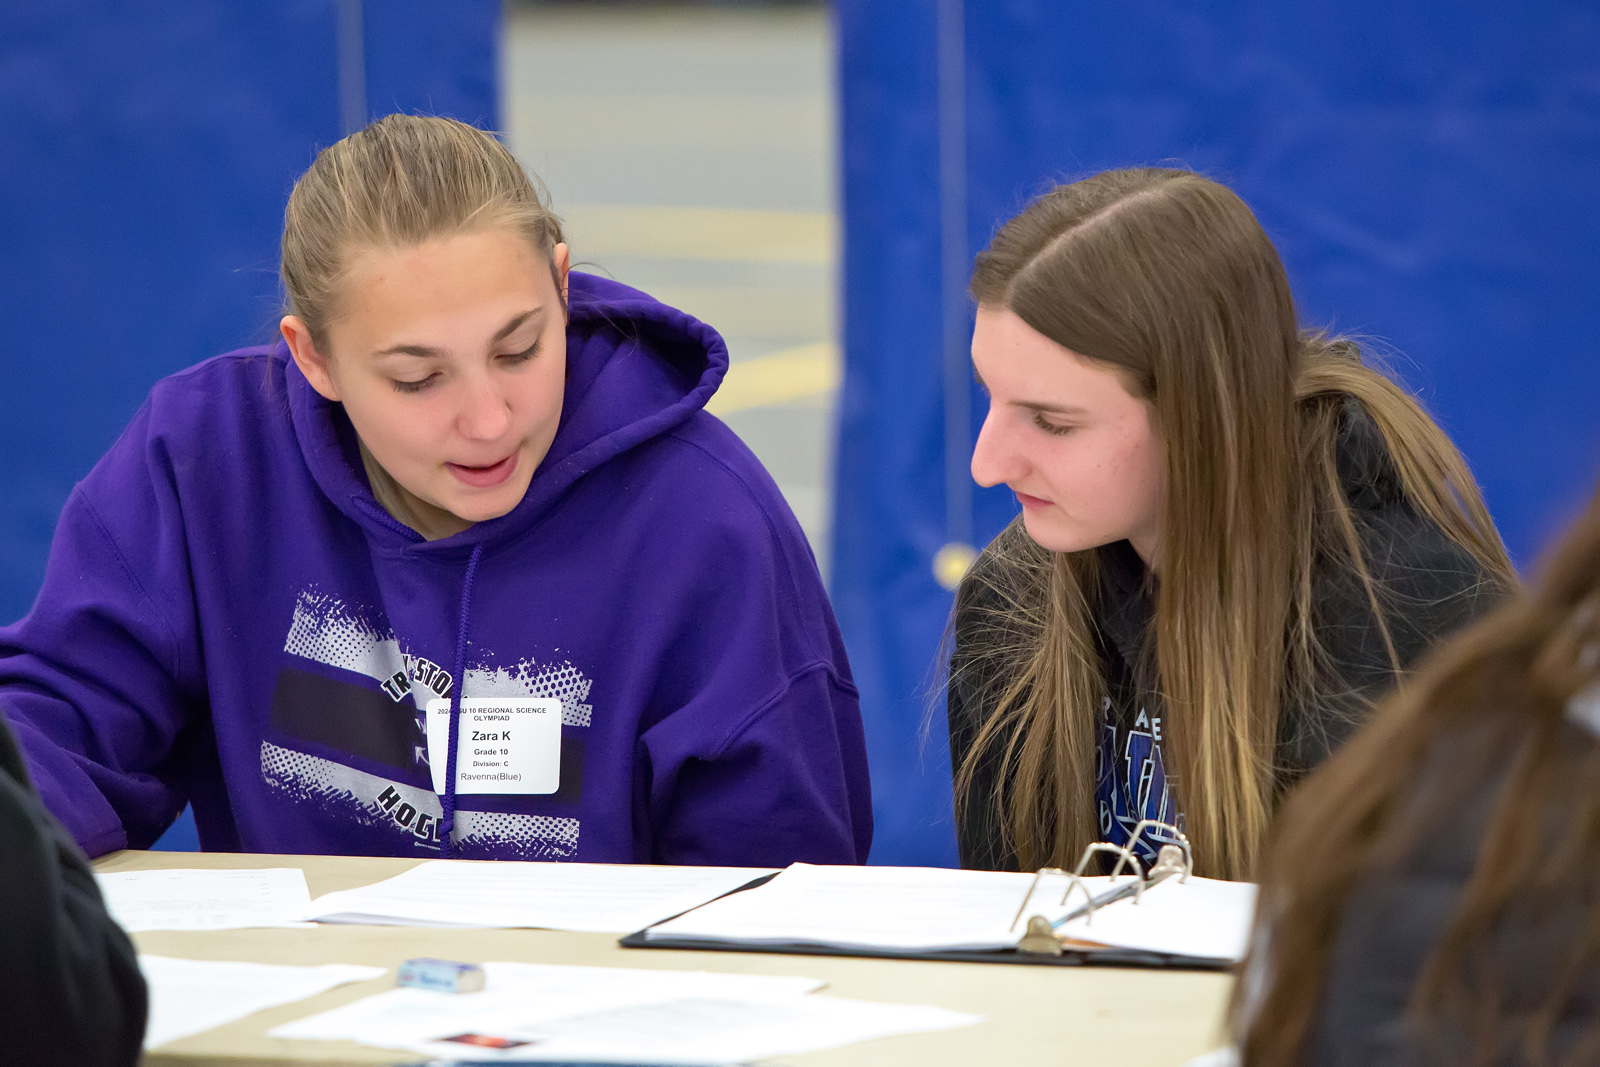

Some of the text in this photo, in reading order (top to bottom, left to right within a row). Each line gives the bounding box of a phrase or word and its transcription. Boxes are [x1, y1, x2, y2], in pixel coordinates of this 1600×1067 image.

[471, 730, 511, 741] Zara K
[460, 772, 522, 782] Ravenna(Blue)
